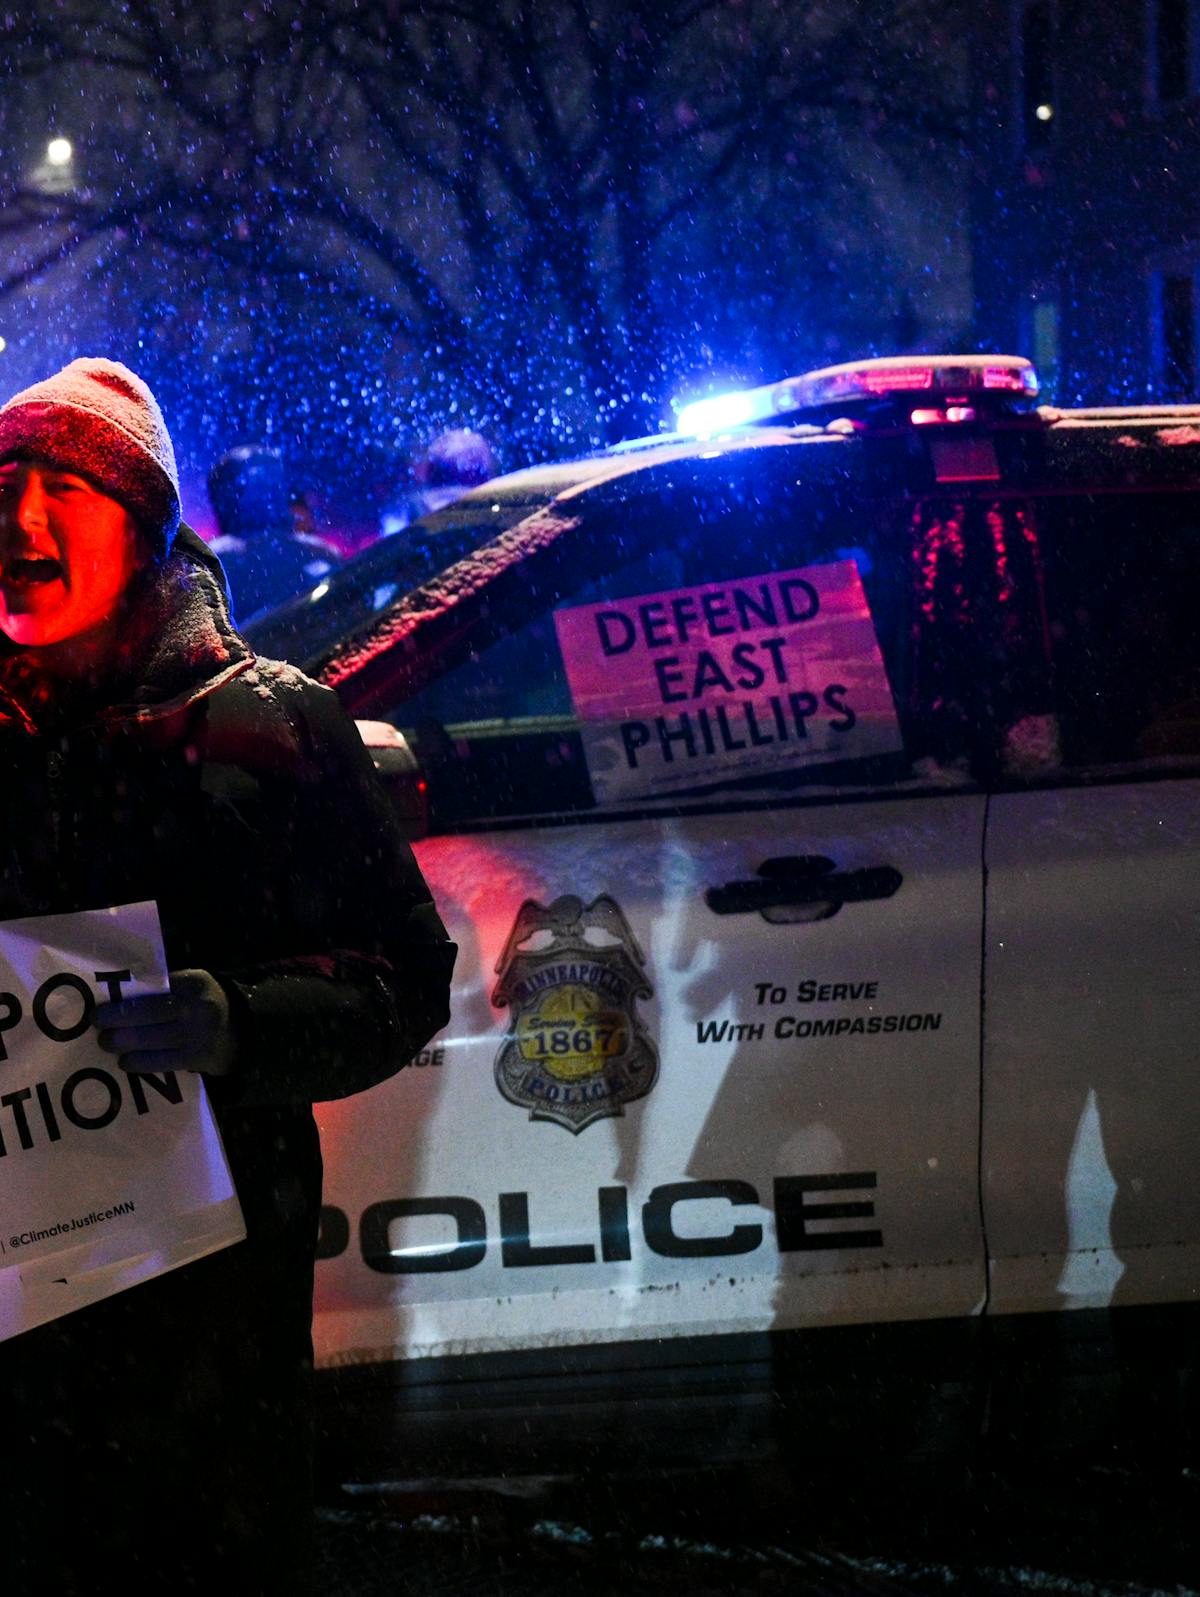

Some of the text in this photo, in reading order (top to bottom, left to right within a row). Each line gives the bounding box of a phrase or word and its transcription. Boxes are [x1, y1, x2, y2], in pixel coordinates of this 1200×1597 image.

[594, 578, 820, 657] DEFEND
[654, 638, 788, 704] EAST
[619, 684, 856, 769] PHILLIPS
[517, 962, 627, 998] MINNEAPOLIS
[534, 1029, 613, 1055] 1867
[527, 1077, 622, 1104] POLICE
[9, 1200, 136, 1249] @ClimateJusticeMN
